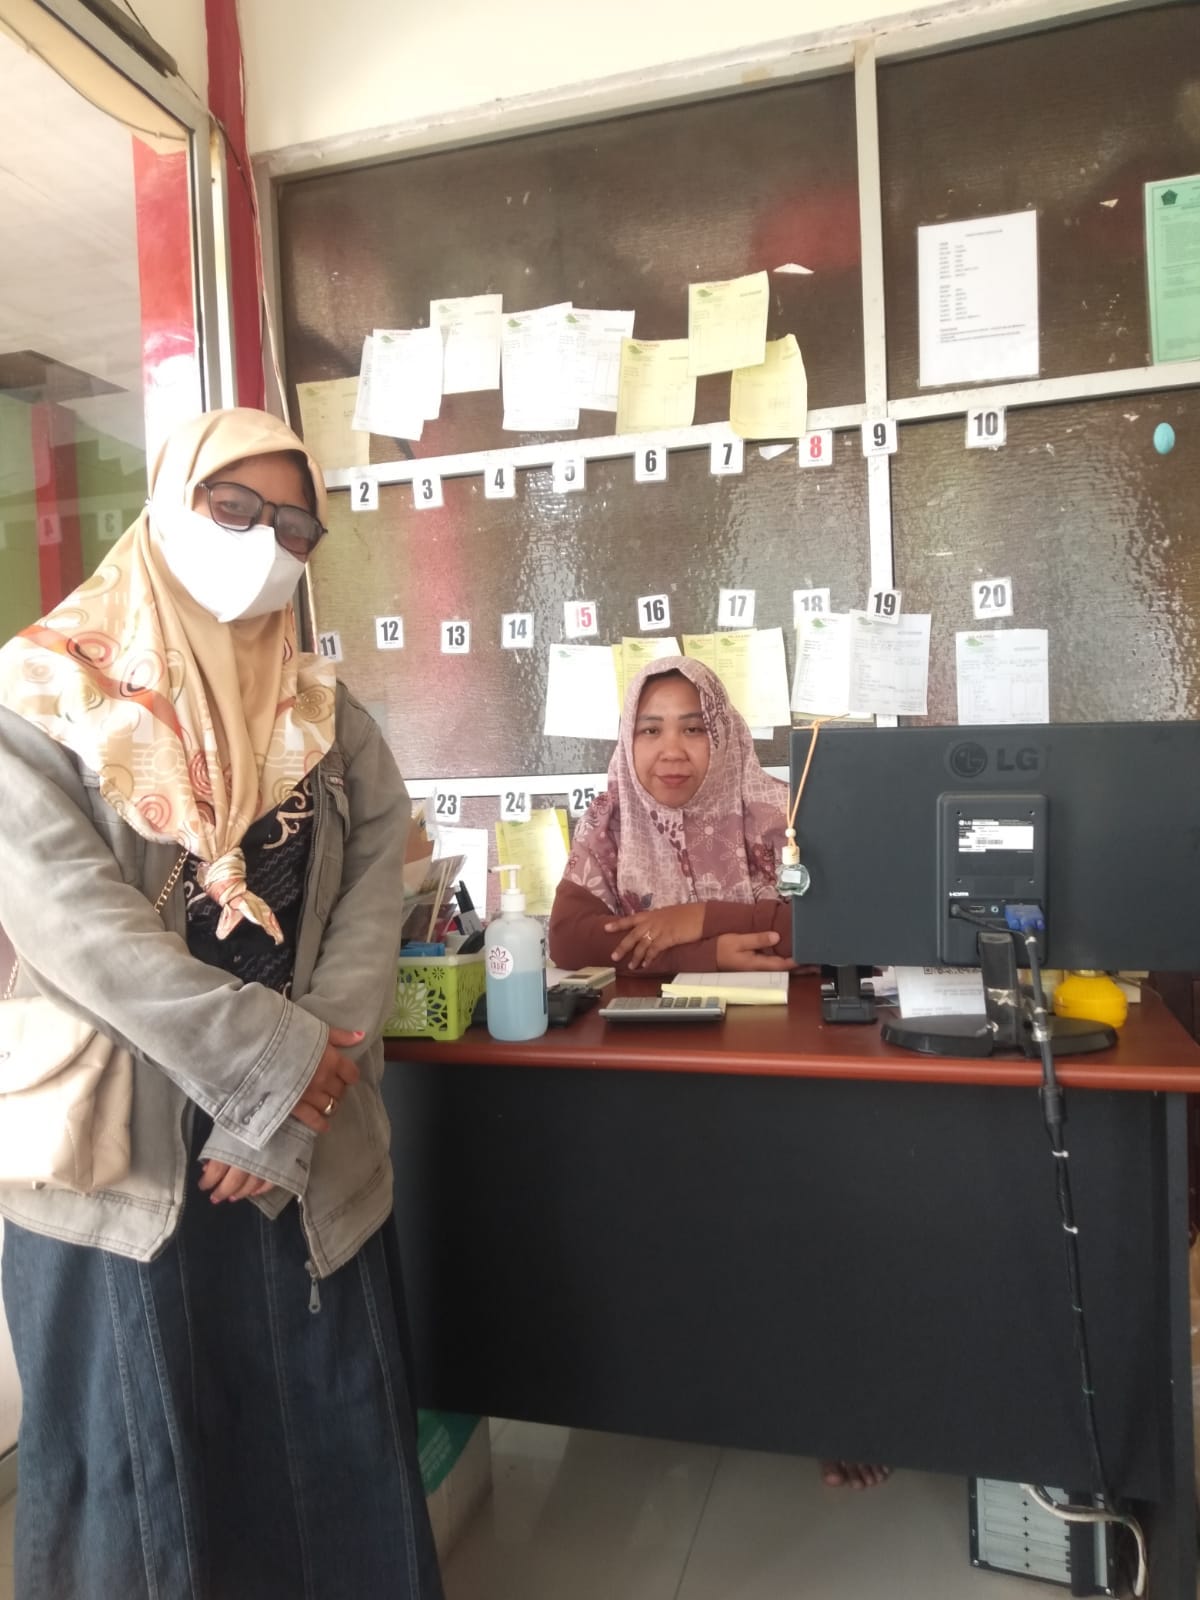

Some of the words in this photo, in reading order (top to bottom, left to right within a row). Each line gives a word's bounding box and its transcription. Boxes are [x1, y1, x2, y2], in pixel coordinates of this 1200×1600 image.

[872, 423, 886, 447] 9
[973, 412, 999, 436] 10
[723, 443, 734, 466] 7
[809, 435, 822, 459] 8
[564, 460, 576, 481] 5
[645, 450, 657, 472] 6
[422, 479, 433, 500] 3
[494, 468, 505, 489] 4
[359, 482, 369, 503] 2
[727, 594, 747, 618] 17
[800, 594, 824, 612] 18
[873, 591, 897, 616] 19
[979, 584, 1008, 609] 20
[643, 600, 666, 622] 16
[380, 621, 399, 641] 12
[446, 626, 465, 647] 13
[508, 618, 527, 640] 14
[320, 635, 336, 656] 11
[997, 747, 1039, 771] LG
[436, 794, 457, 815] 23
[505, 792, 525, 812] 24
[572, 788, 596, 810] 25
